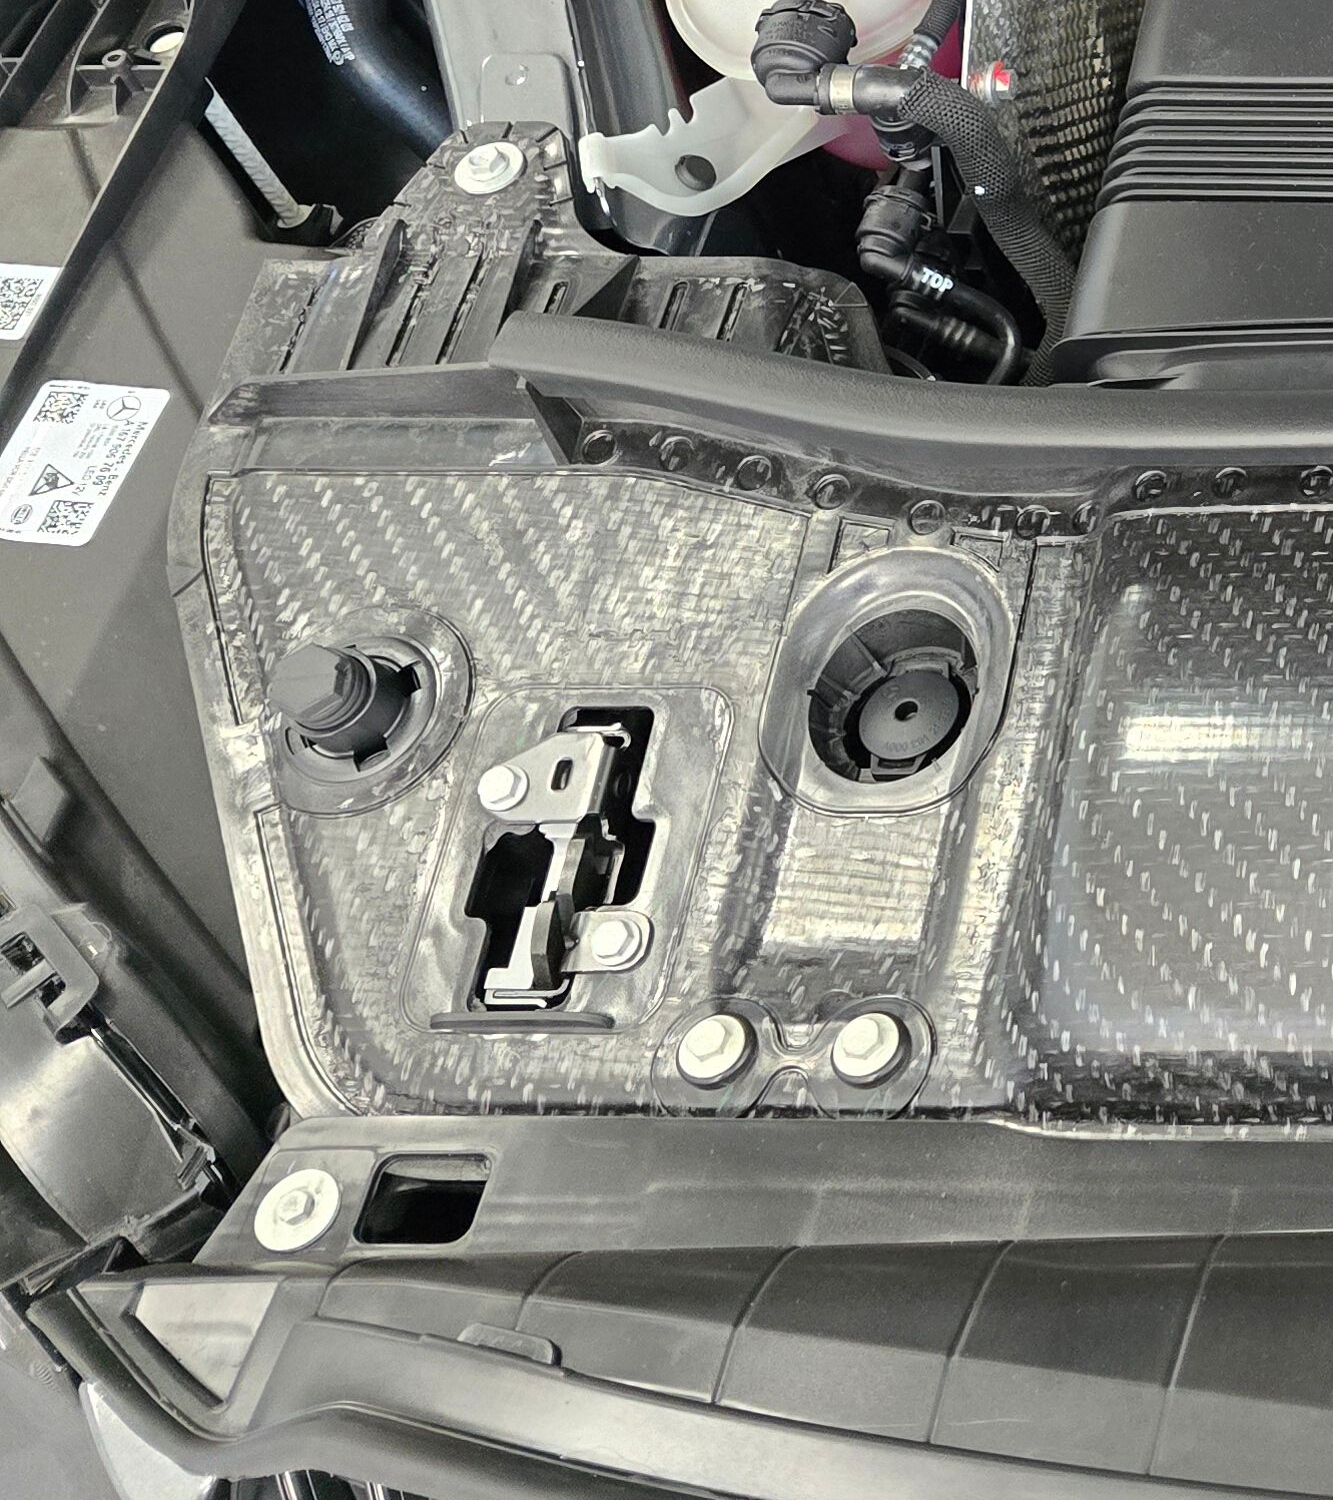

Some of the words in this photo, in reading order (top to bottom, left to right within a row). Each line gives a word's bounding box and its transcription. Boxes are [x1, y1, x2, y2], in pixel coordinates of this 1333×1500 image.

[921, 267, 954, 292] TOP
[116, 421, 148, 465] Mercedes
[120, 426, 133, 443] 167
[97, 475, 119, 496] Benz
